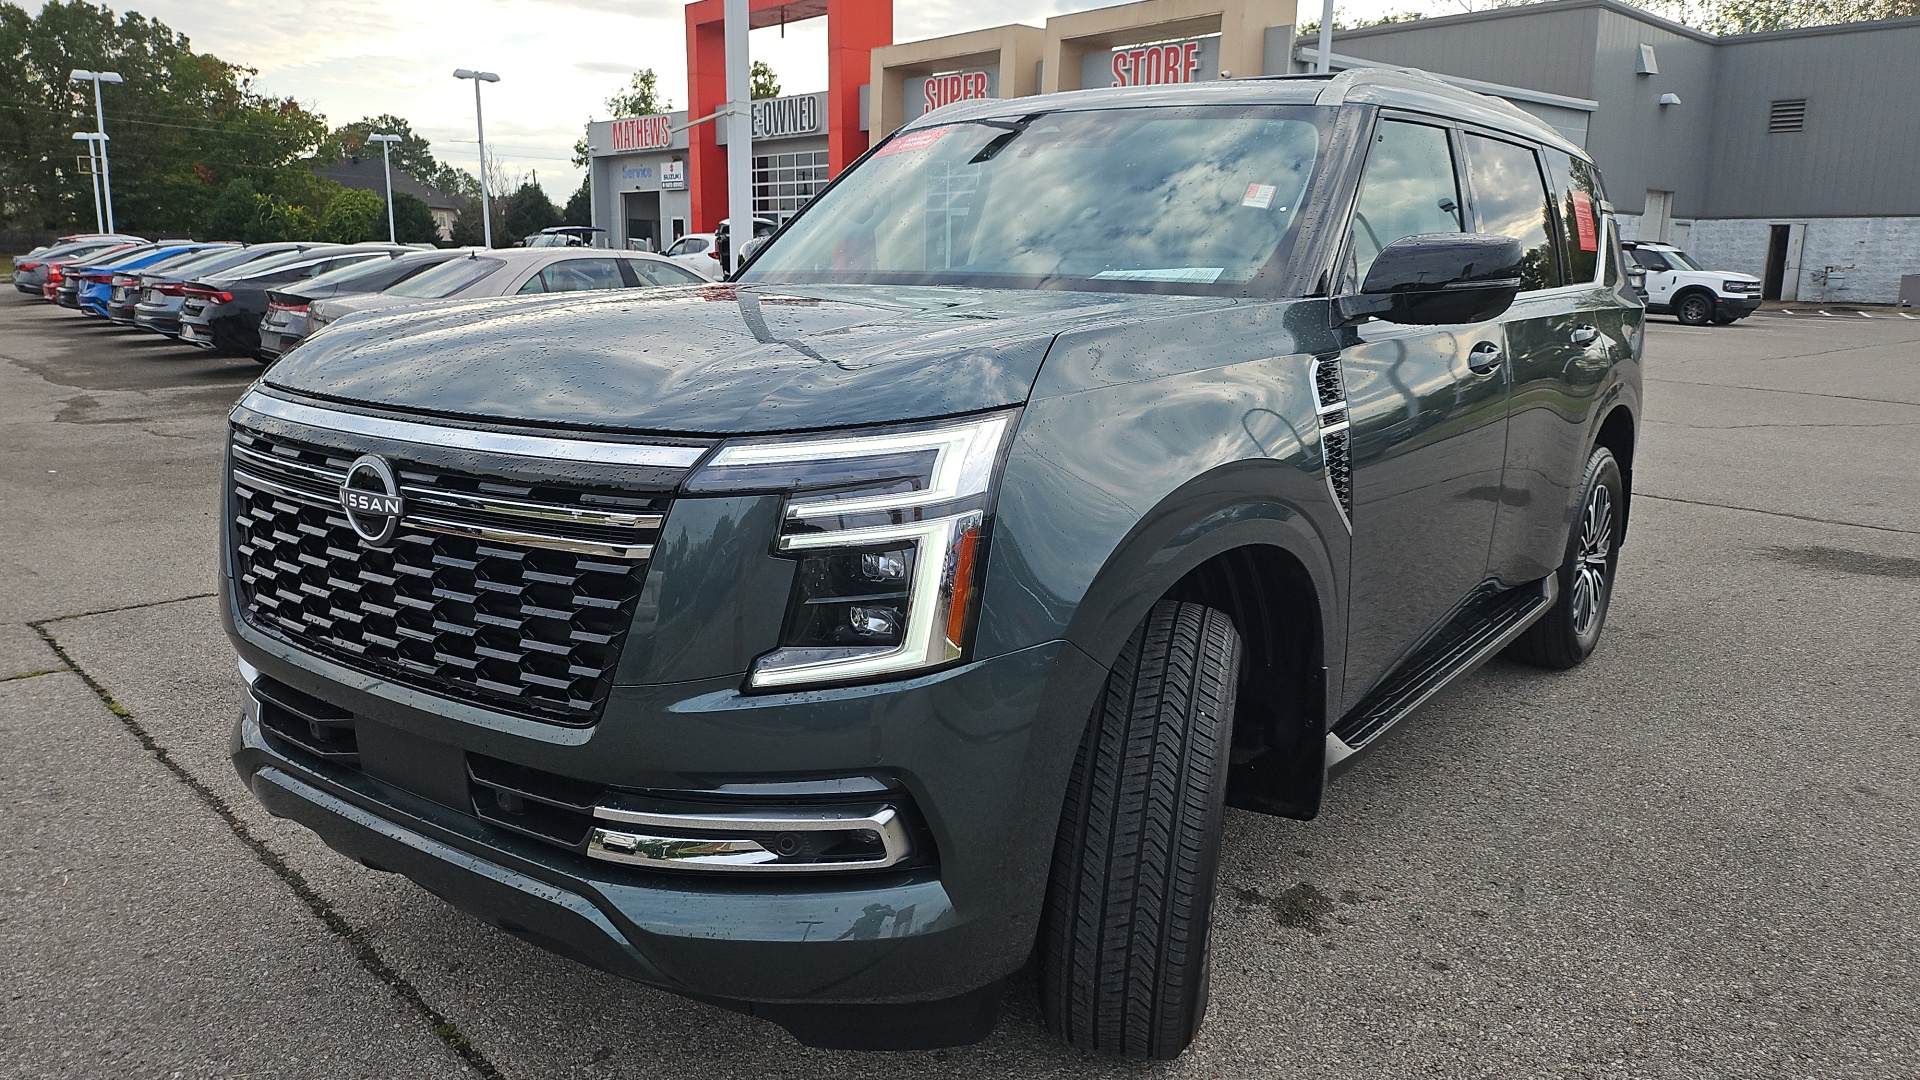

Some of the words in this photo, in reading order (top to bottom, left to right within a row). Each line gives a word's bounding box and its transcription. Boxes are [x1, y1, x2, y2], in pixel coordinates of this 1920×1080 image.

[1112, 42, 1198, 87] STORE
[924, 72, 987, 114] SUPER
[612, 115, 669, 151] MATHEWS
[622, 163, 652, 180] Service
[663, 173, 681, 181] SUZUKI
[340, 491, 399, 513] NISSAN
